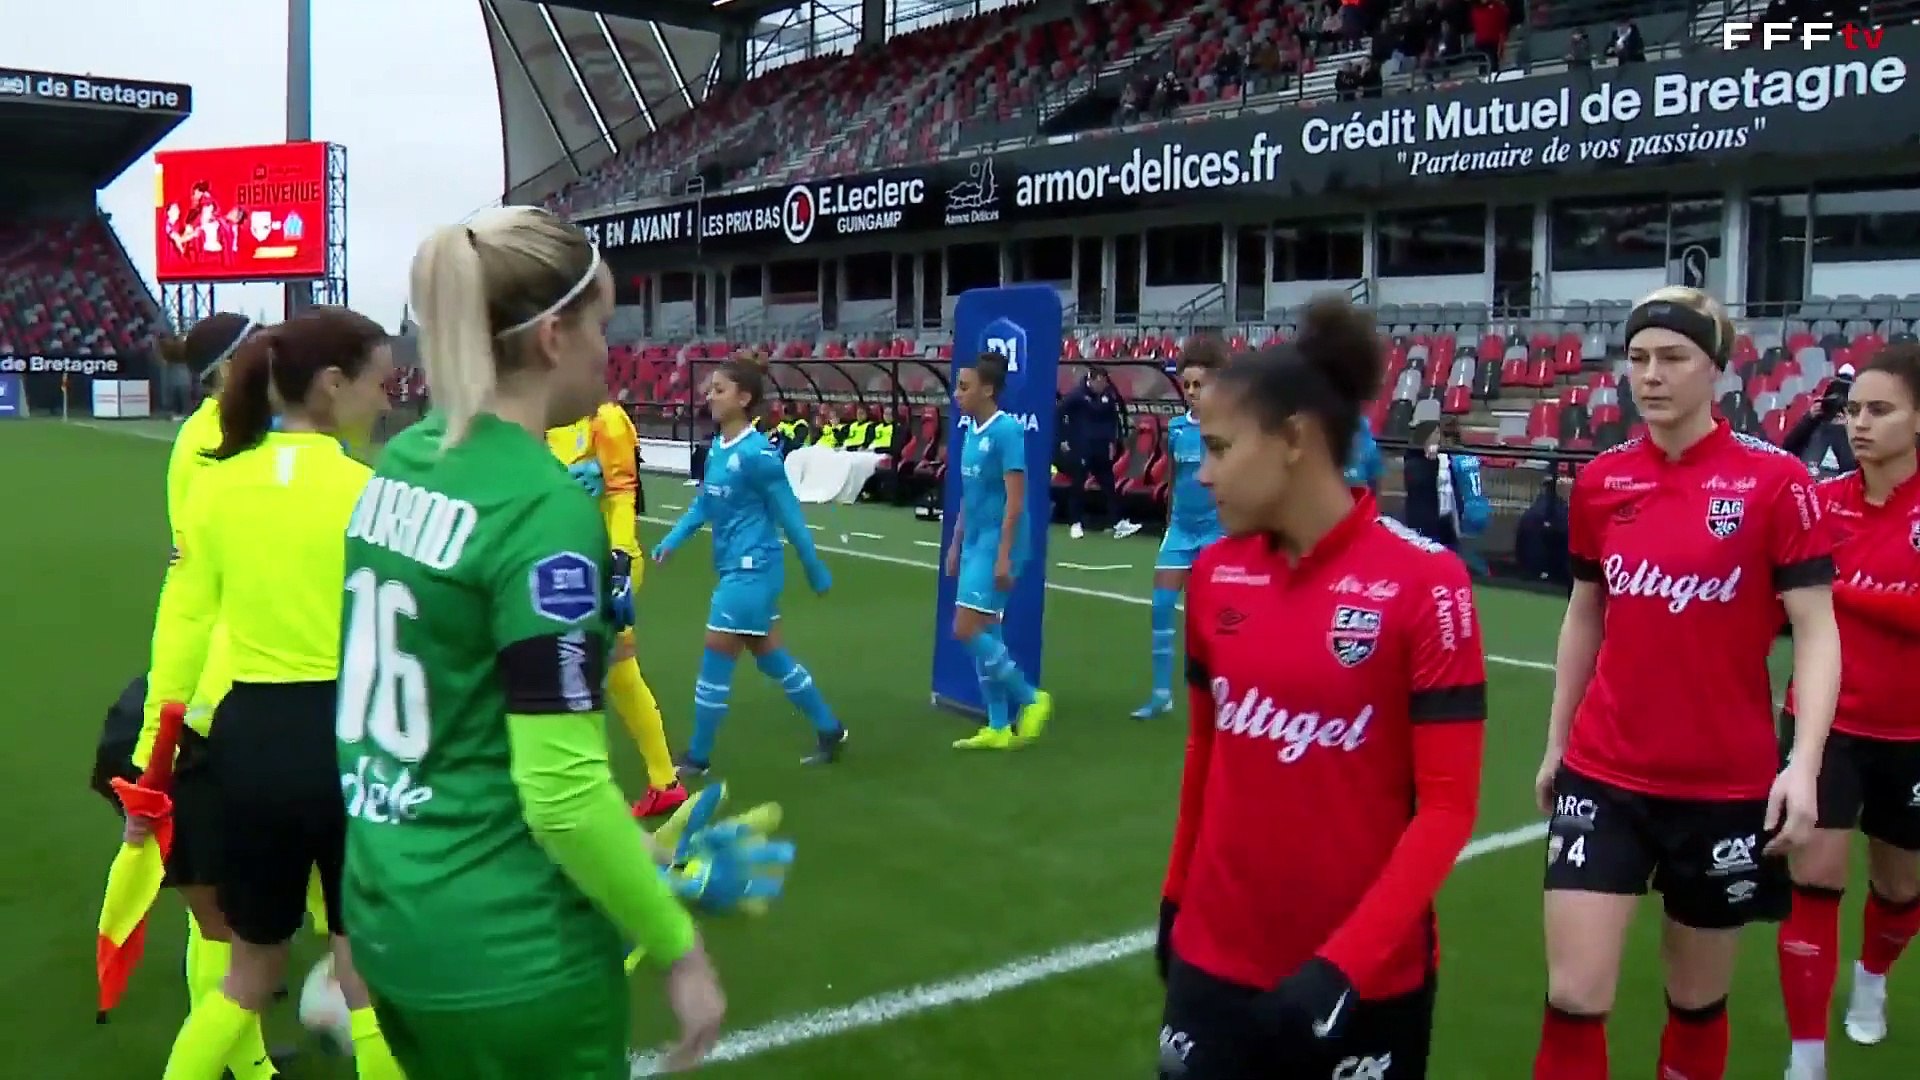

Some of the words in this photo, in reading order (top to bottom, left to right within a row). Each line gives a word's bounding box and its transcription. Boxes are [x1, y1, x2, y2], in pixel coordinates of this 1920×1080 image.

[0, 76, 31, 95] el
[37, 78, 68, 97] de
[74, 80, 179, 108] Bretagne
[1301, 104, 1416, 155] Crédit
[1425, 87, 1569, 143] Mutuel
[1580, 82, 1643, 126] de
[1653, 54, 1907, 113] Bretagne
[1541, 134, 1572, 165] de
[1579, 137, 1622, 162] vos
[1016, 131, 1283, 208] armor-delices.fr
[237, 182, 321, 206] BIENVENUE
[818, 178, 925, 215] E.Leclerc
[606, 220, 625, 249] EN
[630, 210, 682, 245] AVANT
[702, 215, 724, 238] LES
[725, 209, 753, 235] PRIX
[755, 206, 781, 231] BAS
[837, 211, 902, 235] GUINGAMP
[30, 356, 119, 375] Bretagne
[1712, 500, 1741, 515] EAG
[336, 566, 433, 763] 16
[1567, 834, 1586, 868] 4
